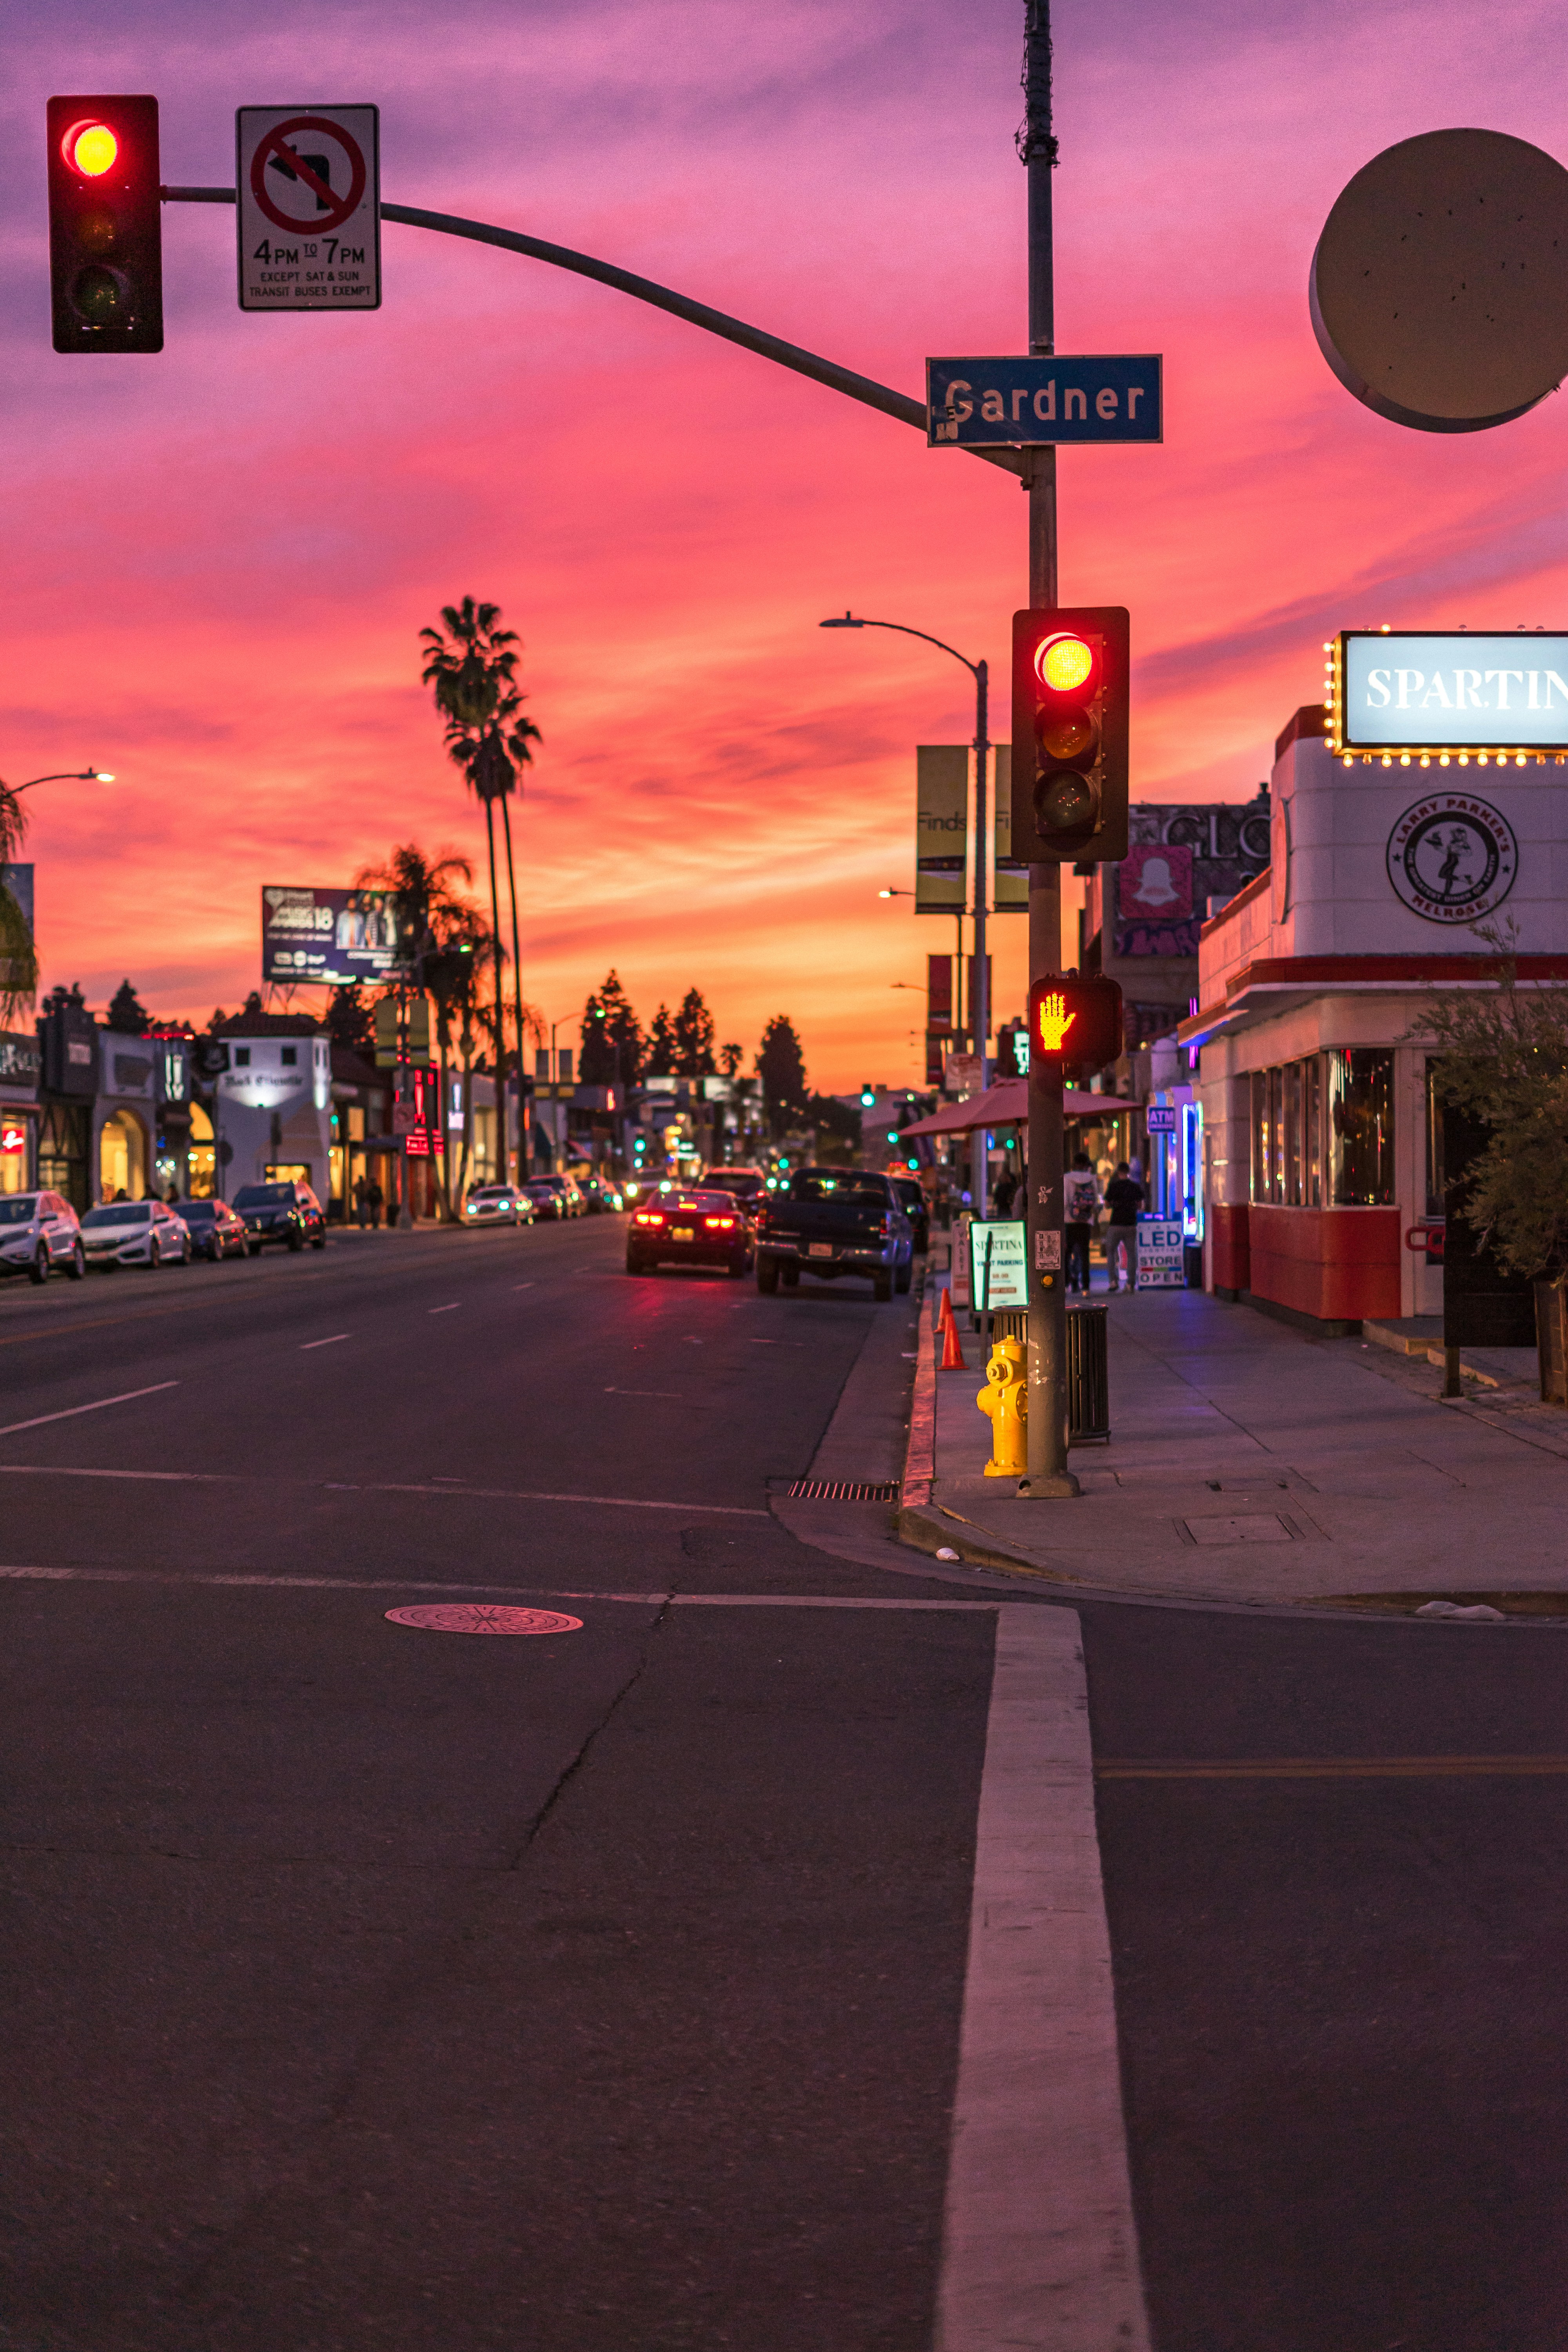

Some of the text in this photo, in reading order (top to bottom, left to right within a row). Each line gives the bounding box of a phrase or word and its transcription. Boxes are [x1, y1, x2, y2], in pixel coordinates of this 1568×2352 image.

[304, 243, 317, 256] TO
[260, 271, 359, 281] EXCEPT SAT & SUN
[250, 286, 371, 297] TRANSIT BUSES EXEMPT
[946, 379, 1145, 422] Gardner
[918, 811, 966, 831] Finds
[1396, 799, 1510, 853] LARRY PARKER'S
[1412, 895, 1486, 916] MELROSE
[1150, 1110, 1174, 1123] ATM
[975, 1240, 1022, 1251] SPRTINA
[1139, 1231, 1181, 1247] LED
[1140, 1256, 1181, 1266] STORE
[1140, 1272, 1182, 1282] OPEN
